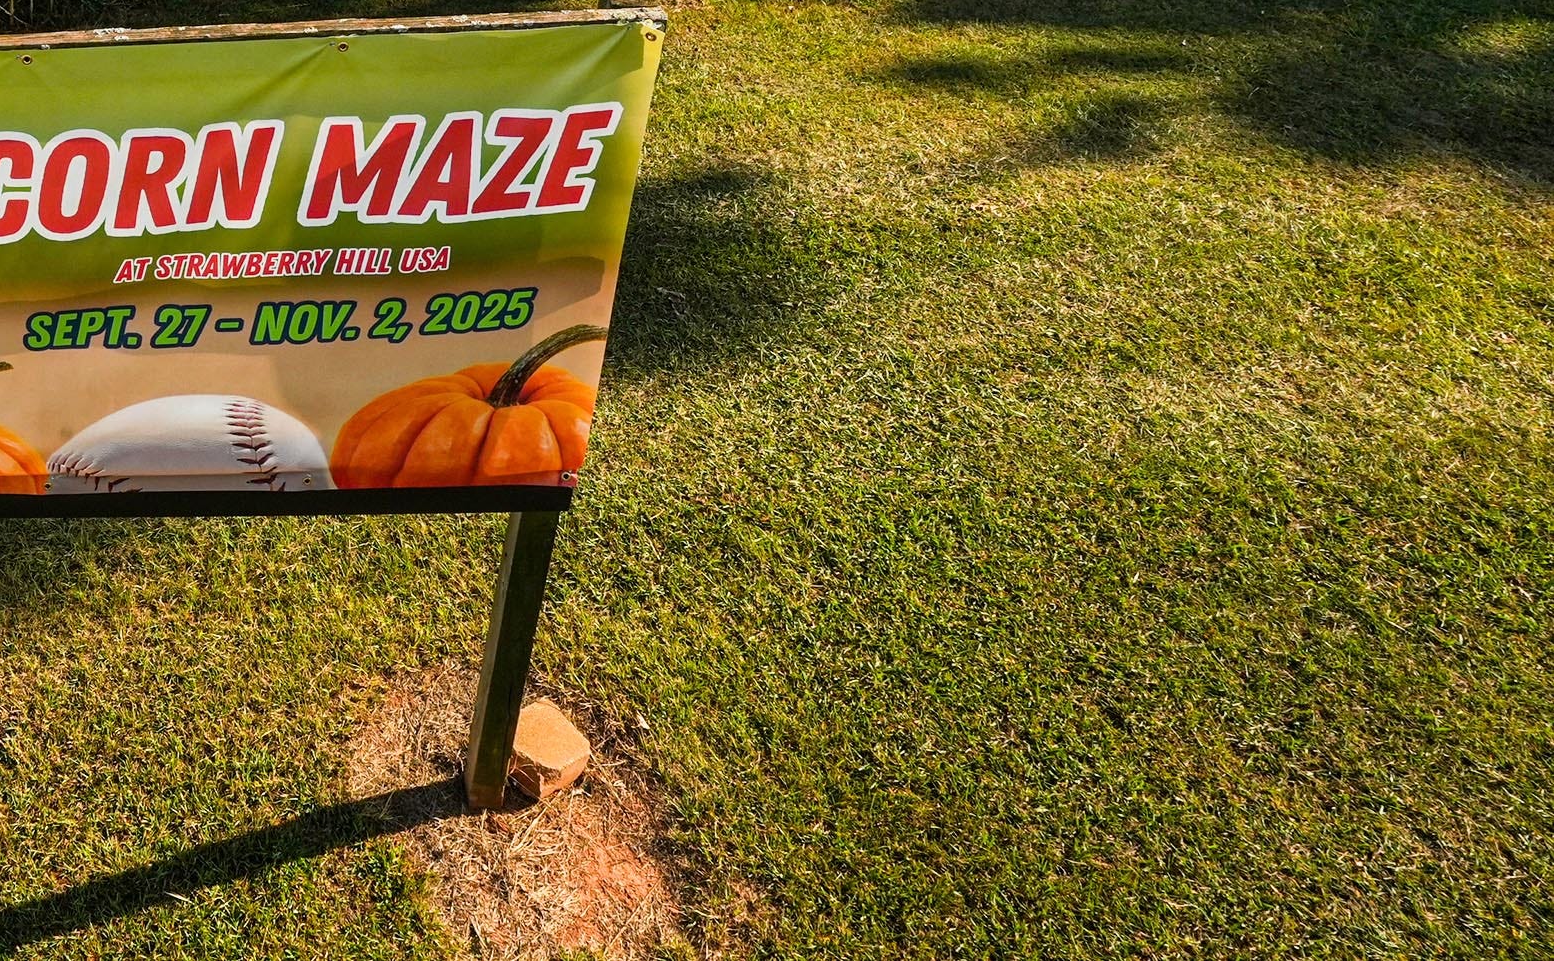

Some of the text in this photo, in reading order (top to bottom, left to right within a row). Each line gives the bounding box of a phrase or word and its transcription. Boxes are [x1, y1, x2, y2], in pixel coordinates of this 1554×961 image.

[301, 105, 619, 224] MAZE
[114, 246, 450, 283] AT STRAWBERRY HILL USA
[25, 306, 141, 350] SEPT.
[152, 305, 210, 347] 27
[251, 301, 359, 343] NOV.
[370, 299, 410, 342] 2,
[421, 289, 536, 334] 2025
